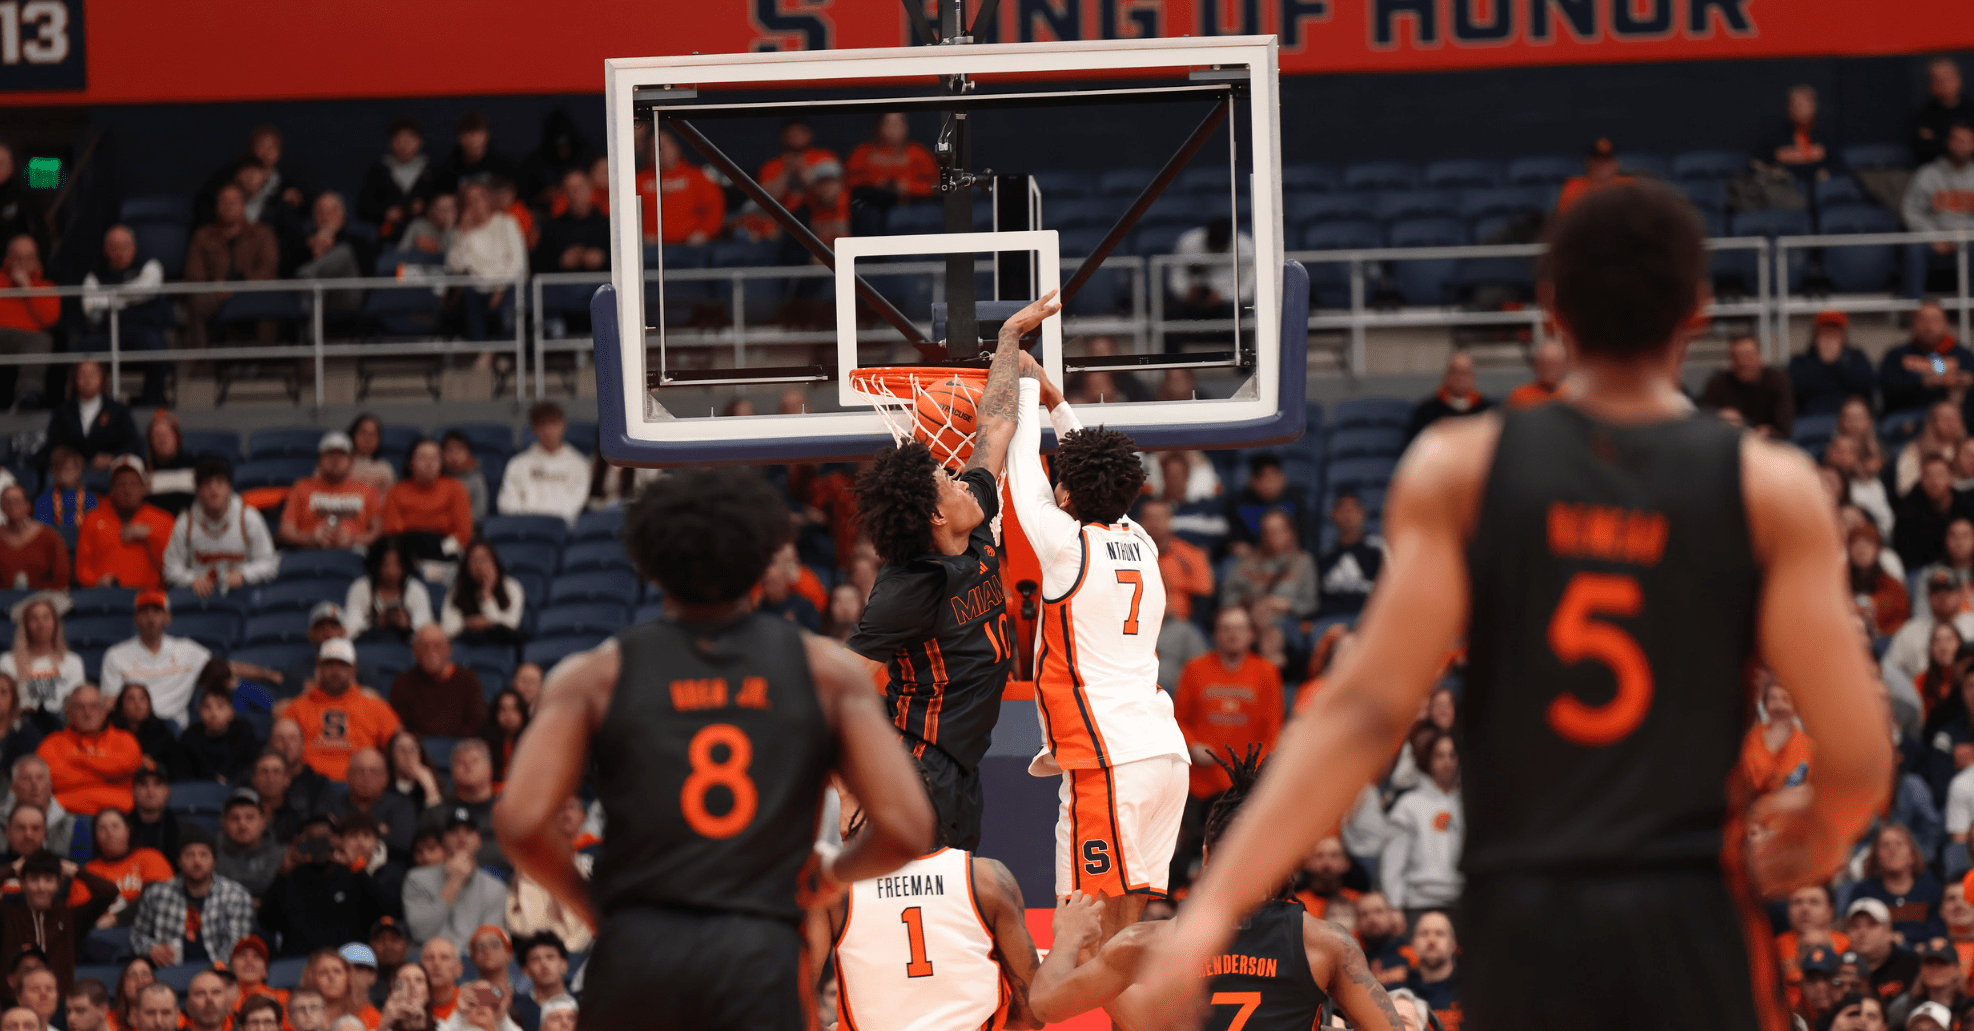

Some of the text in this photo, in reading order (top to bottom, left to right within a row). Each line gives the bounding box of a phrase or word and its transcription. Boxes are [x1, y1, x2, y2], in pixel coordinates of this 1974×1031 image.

[0, 0, 70, 66] 13
[1106, 541, 1141, 562] NTHONY
[1115, 569, 1144, 635] 7
[983, 612, 1011, 664] 10
[1546, 570, 1656, 747] 5
[680, 722, 759, 840] 8
[1082, 838, 1111, 875] S
[877, 875, 944, 898] FREEMAN
[901, 906, 934, 978] 1
[1210, 991, 1262, 1031] 7
